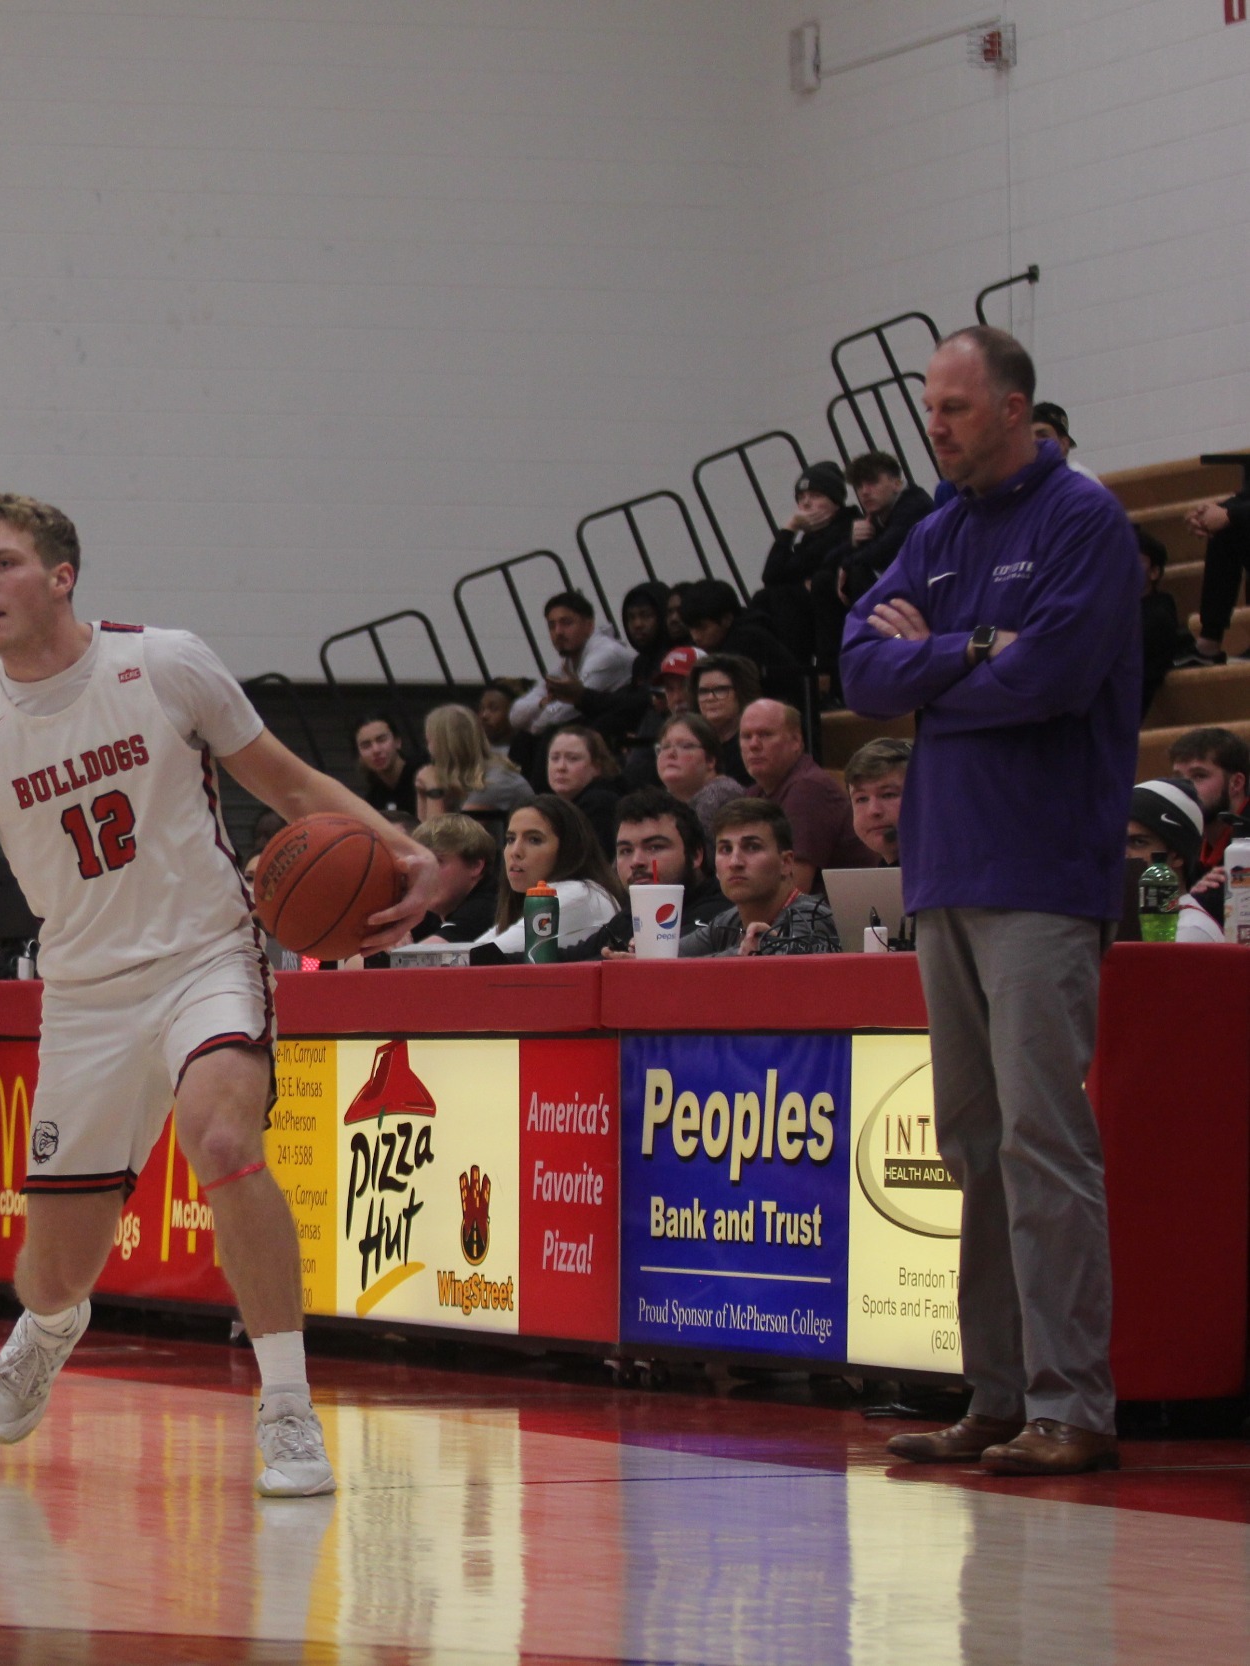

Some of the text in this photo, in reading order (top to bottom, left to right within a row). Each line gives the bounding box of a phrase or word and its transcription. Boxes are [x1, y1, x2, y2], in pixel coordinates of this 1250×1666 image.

[11, 734, 150, 810] BULLDOGS
[60, 789, 137, 880] 12
[275, 1043, 326, 1069] e-In, Carryout
[288, 1077, 295, 1097] E.
[296, 1077, 323, 1098] Kansas
[274, 1110, 317, 1131] McPherson
[526, 1091, 611, 1135] America's
[641, 1068, 835, 1182] Peoples
[277, 1144, 313, 1166] 241-5588
[885, 1114, 940, 1155] INT
[345, 1121, 435, 1240] Pizza
[532, 1160, 605, 1205] Favorite
[884, 1167, 922, 1181] HEALTH
[923, 1168, 945, 1182] AND
[171, 1200, 214, 1231] McDon
[295, 1184, 328, 1211] Carryout
[358, 1187, 424, 1292] Hut
[650, 1196, 822, 1246] Bank and Trust
[542, 1229, 594, 1275] Pizza!
[437, 1270, 514, 1316] WingStreet
[899, 1267, 959, 1289] Brandon Tr
[638, 1297, 832, 1343] Proud Sponsor of McPherson College
[862, 1294, 960, 1325] Sports and Family
[931, 1329, 960, 1355] (620)
